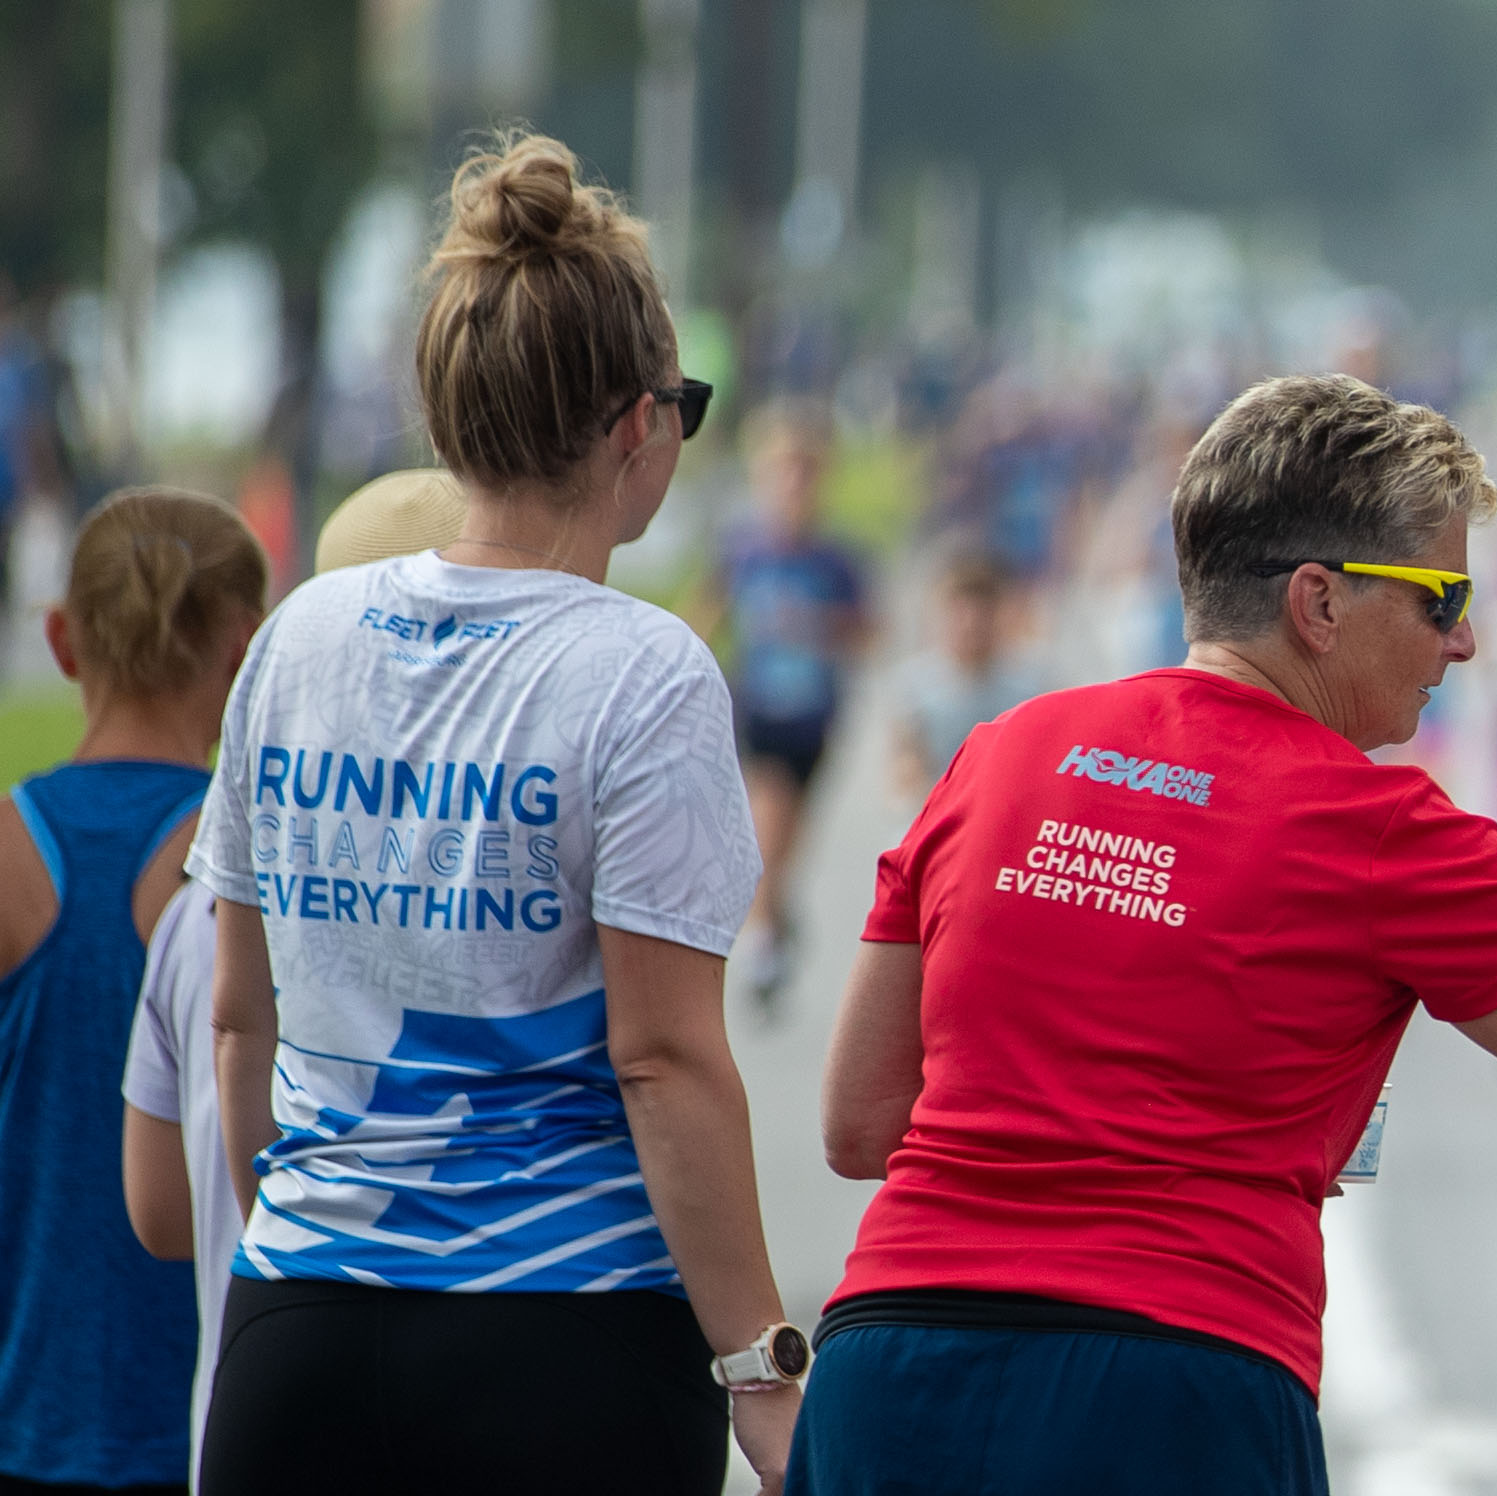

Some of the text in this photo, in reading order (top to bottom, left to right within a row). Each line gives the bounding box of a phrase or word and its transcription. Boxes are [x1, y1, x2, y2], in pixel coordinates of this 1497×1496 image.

[358, 607, 428, 642] FLEET
[256, 746, 558, 826] RUNNING
[1057, 745, 1215, 796] HOKA ONE
[1163, 782, 1211, 807] ONE
[252, 813, 559, 881] CHANGES
[1037, 819, 1177, 868] RUNNING
[1026, 845, 1172, 896] CHANGES
[256, 872, 562, 933] EVERYTHING
[995, 867, 1187, 927] EVERYTHING
